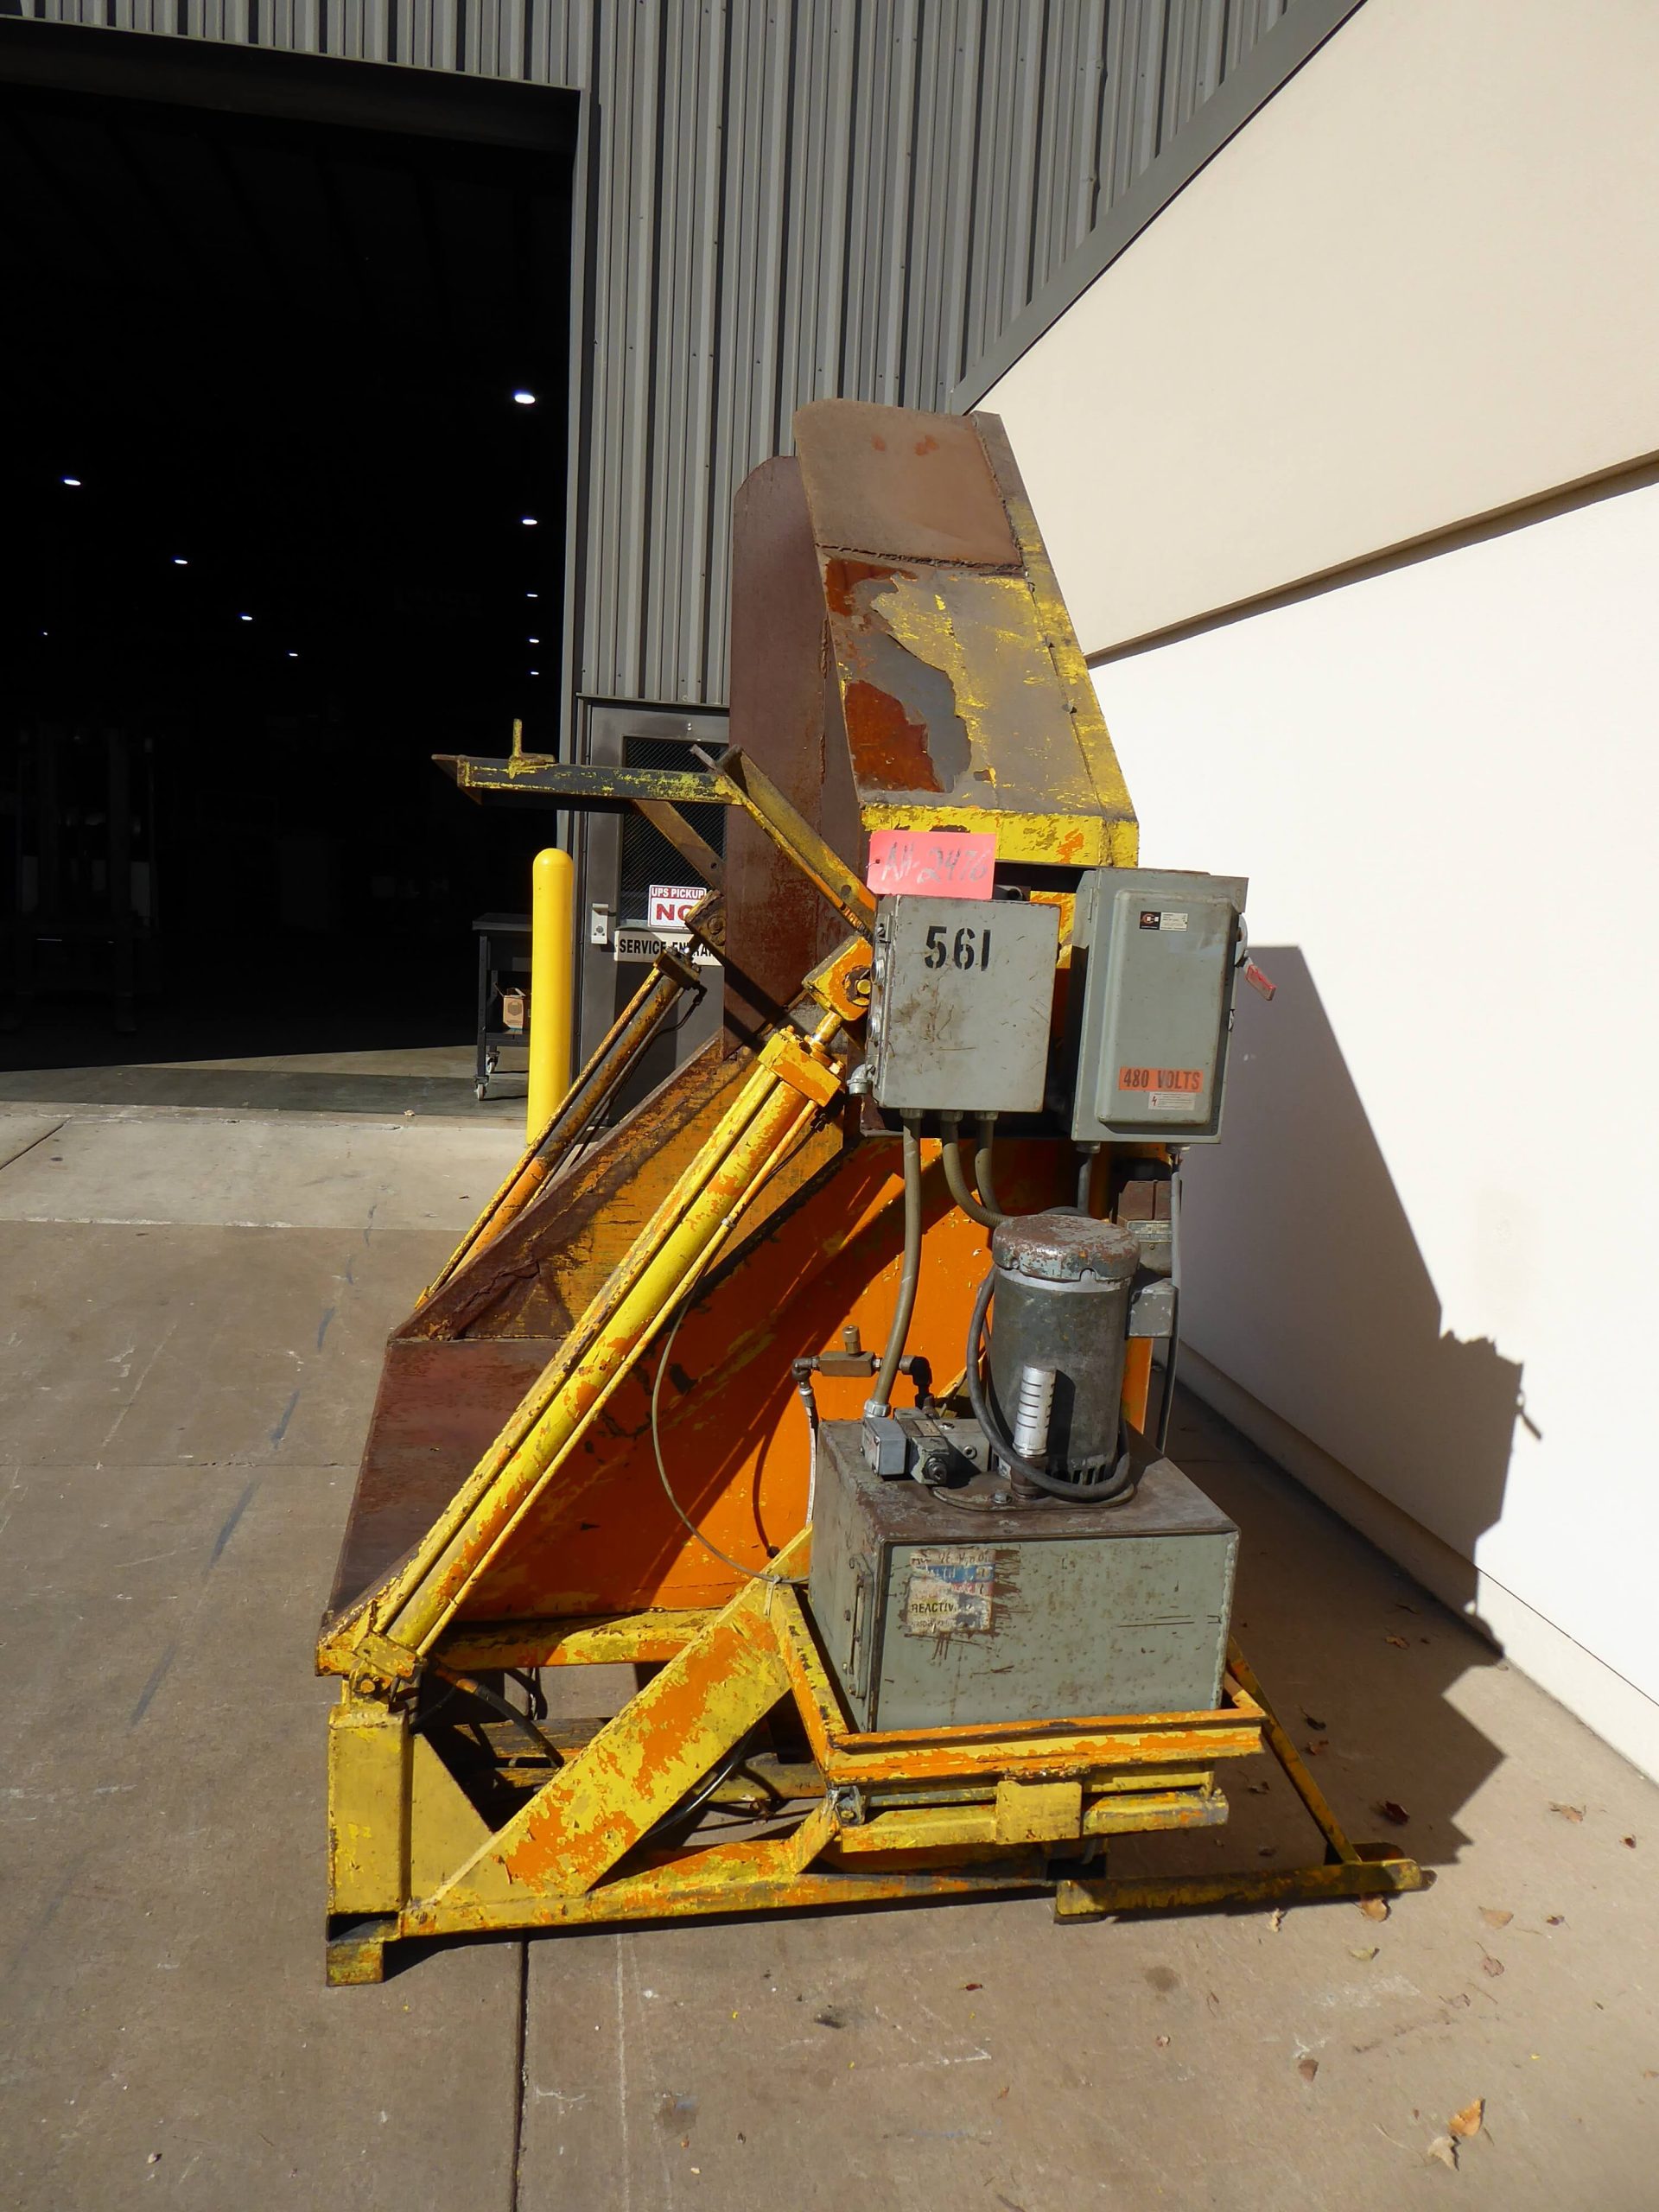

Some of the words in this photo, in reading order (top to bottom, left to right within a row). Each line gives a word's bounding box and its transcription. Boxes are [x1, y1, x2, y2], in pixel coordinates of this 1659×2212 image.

[652, 887, 669, 897] UPS
[671, 888, 704, 899] PICKUP
[620, 938, 666, 955] SERVICE
[924, 925, 991, 971] 561
[1124, 1069, 1149, 1088] 480
[1157, 1070, 1200, 1090] VOLTS
[912, 1602, 957, 1614] REACTIV
